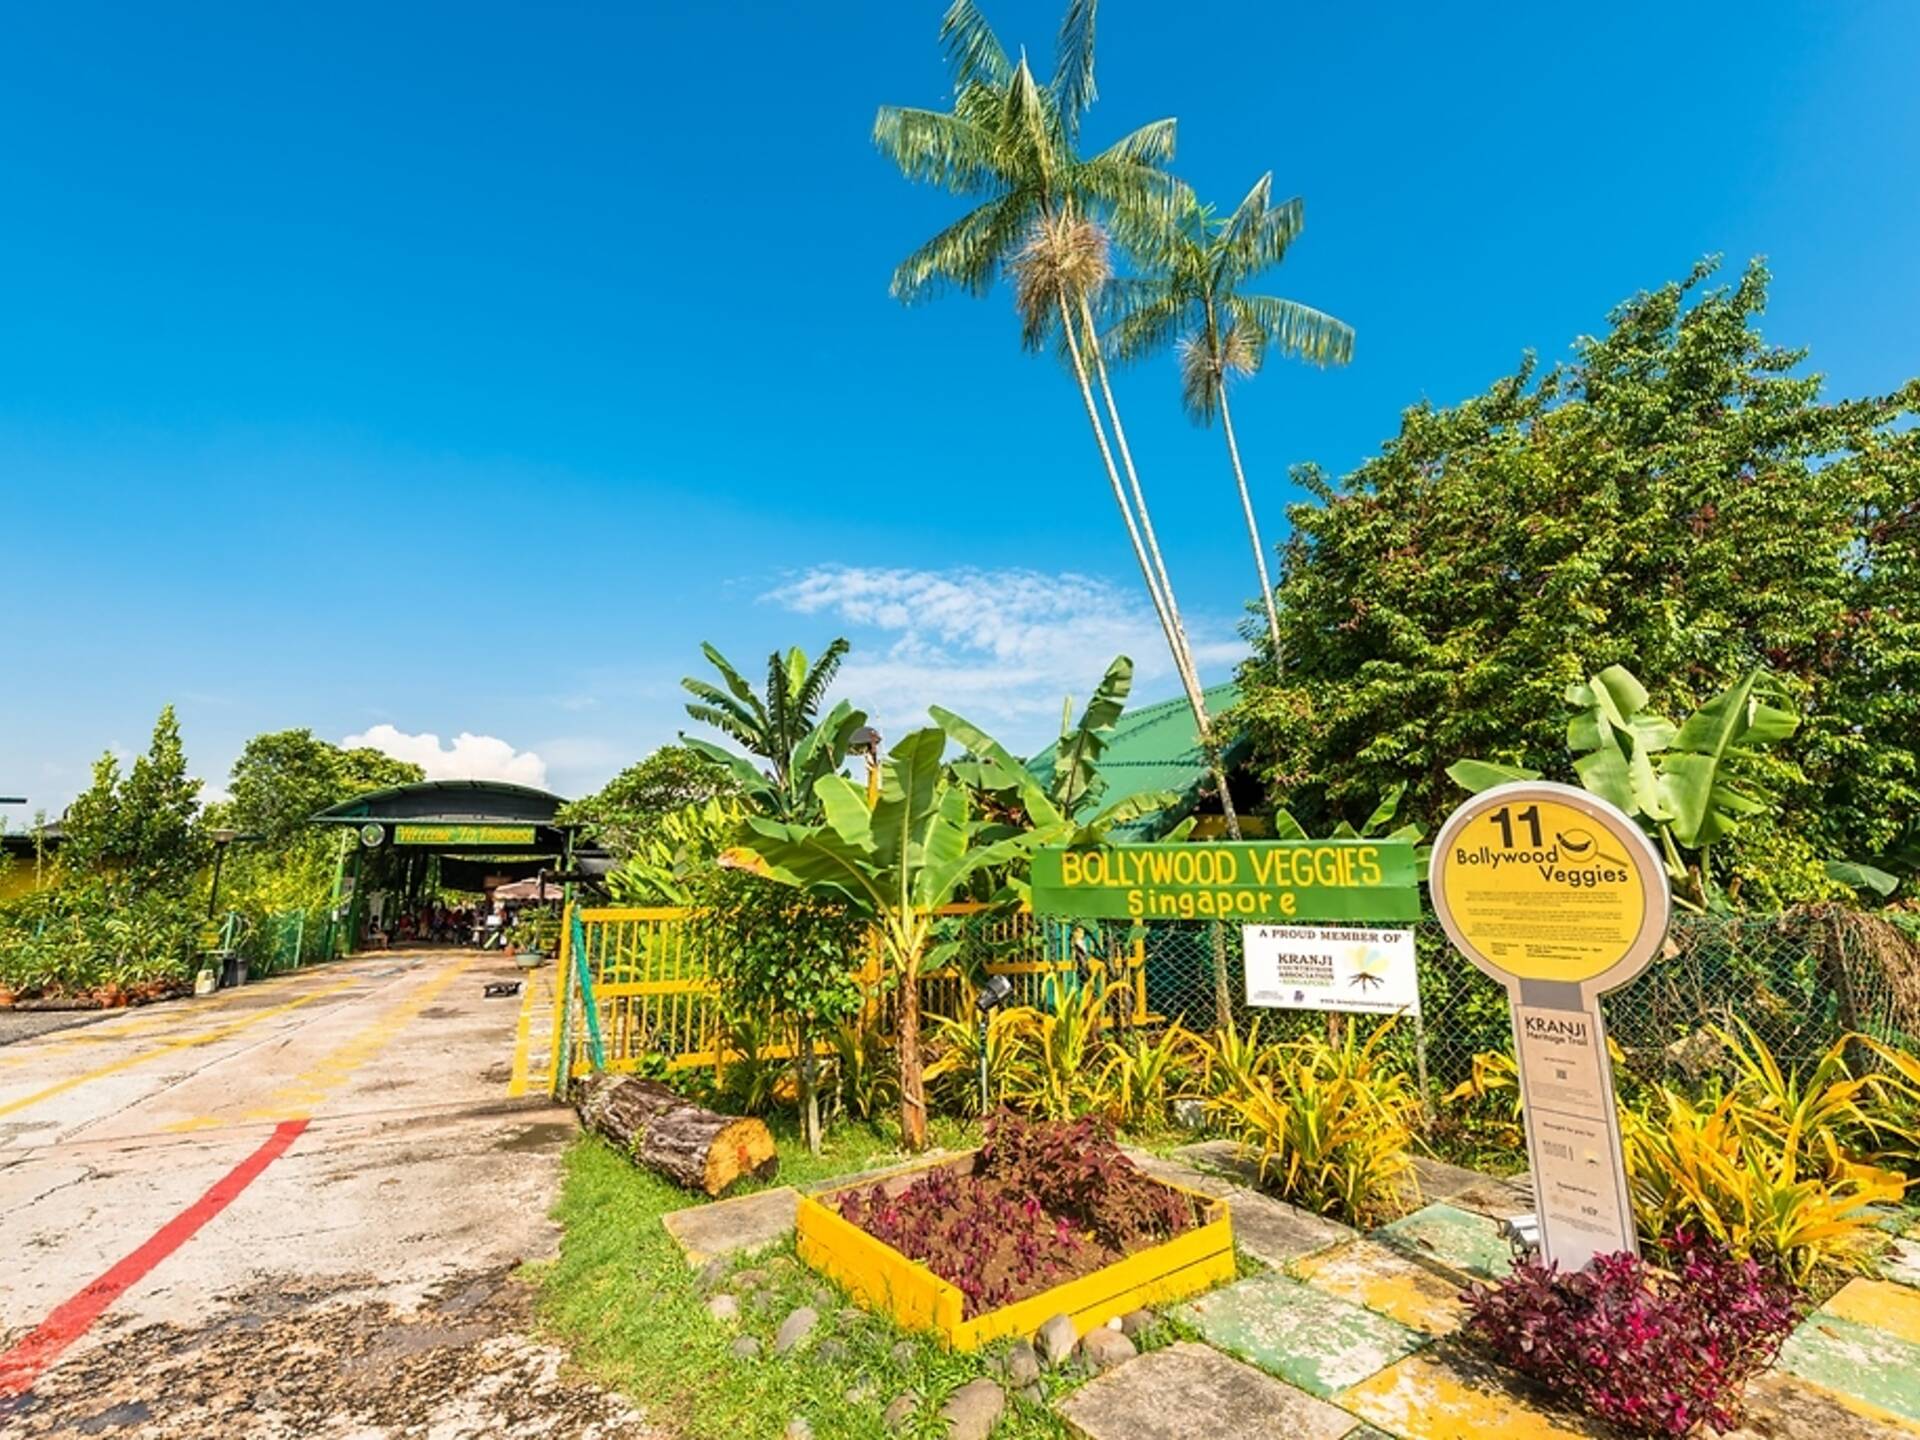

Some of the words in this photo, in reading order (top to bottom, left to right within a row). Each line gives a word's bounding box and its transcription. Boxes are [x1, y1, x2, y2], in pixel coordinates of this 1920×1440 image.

[1490, 805, 1543, 848] 11
[1061, 849, 1237, 887] BOLLYWOOD
[1248, 846, 1382, 887] VEGGIES
[1456, 845, 1559, 869] Bollywood
[1538, 865, 1628, 888] Veggies
[1127, 888, 1297, 919] Singapore
[1259, 929, 1268, 938] A
[1272, 929, 1316, 939] PROUD
[1320, 931, 1379, 943] MEMBER
[1383, 933, 1401, 944] OF
[1277, 952, 1333, 966] KRANJI
[1524, 1016, 1587, 1037] KRANJI
